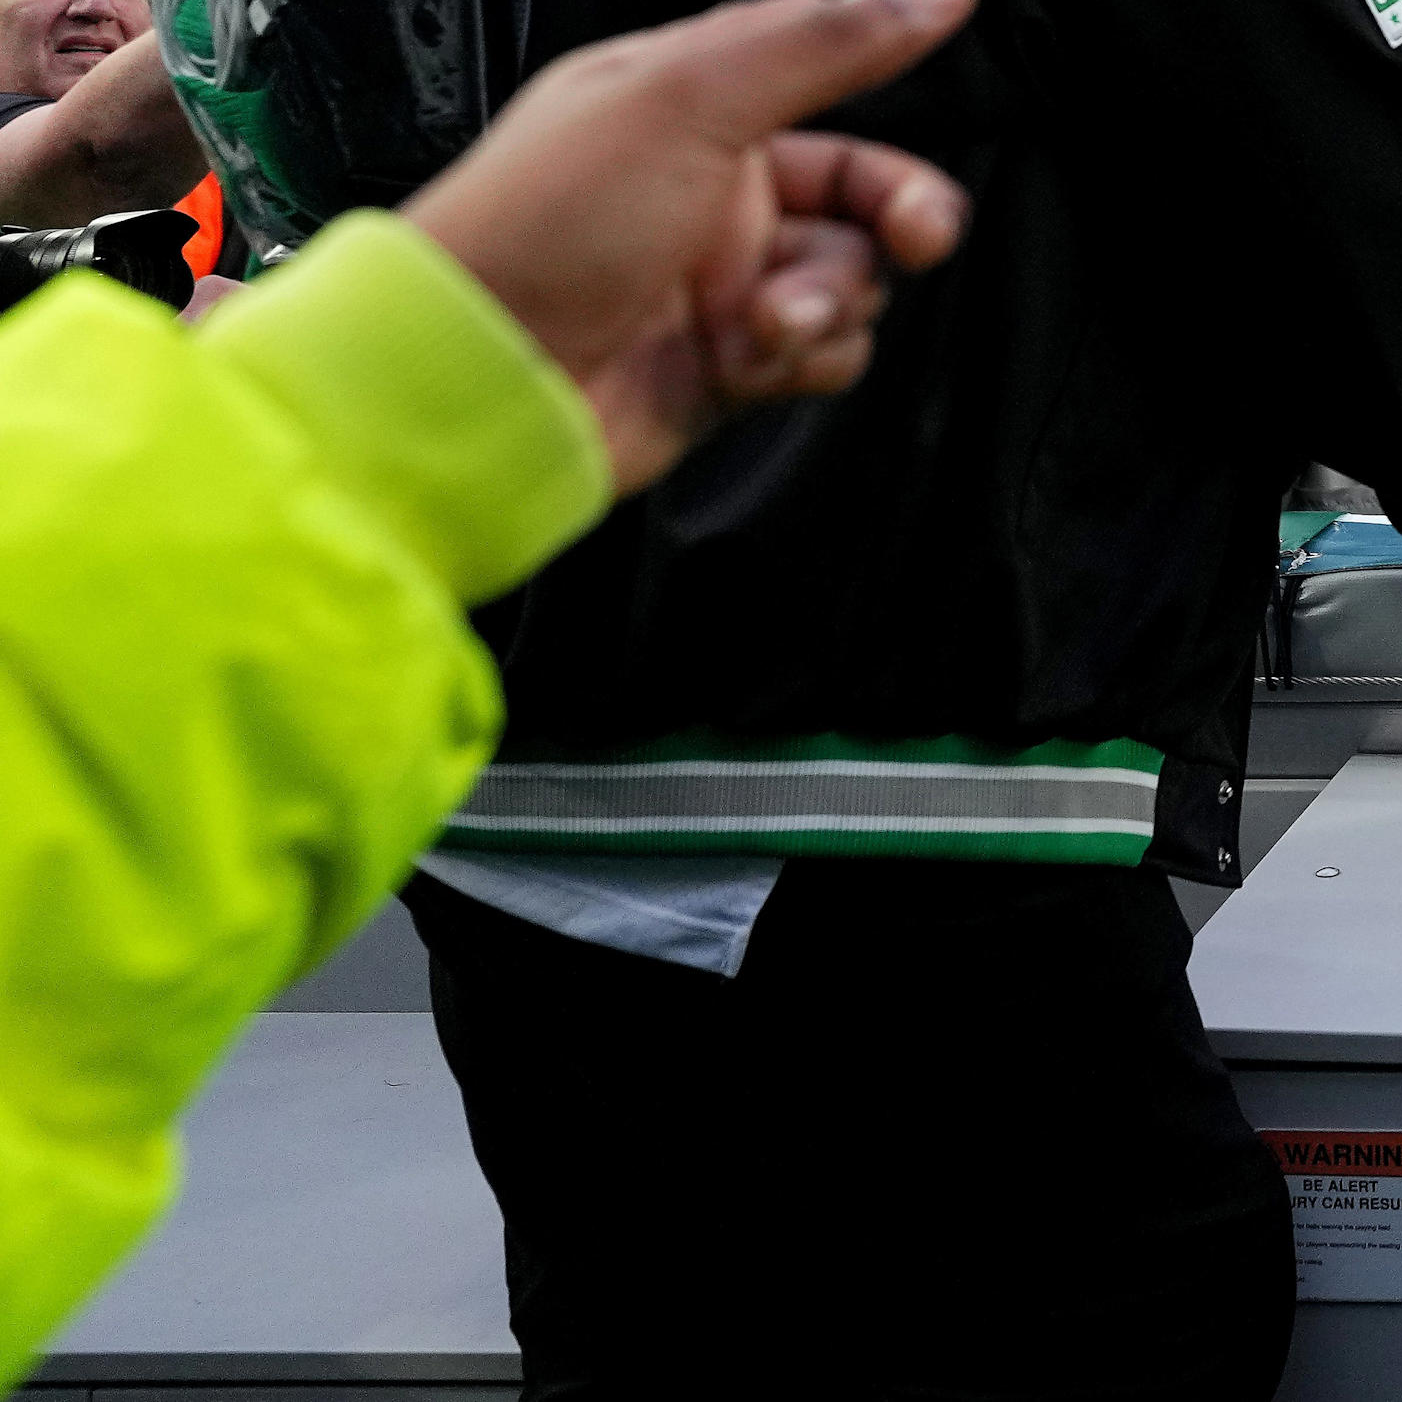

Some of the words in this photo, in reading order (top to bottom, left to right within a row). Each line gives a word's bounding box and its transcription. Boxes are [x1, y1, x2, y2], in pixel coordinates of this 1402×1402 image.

[1303, 1180, 1323, 1192] BE
[1328, 1180, 1378, 1193] ALERT
[1322, 1198, 1354, 1210] CAN
